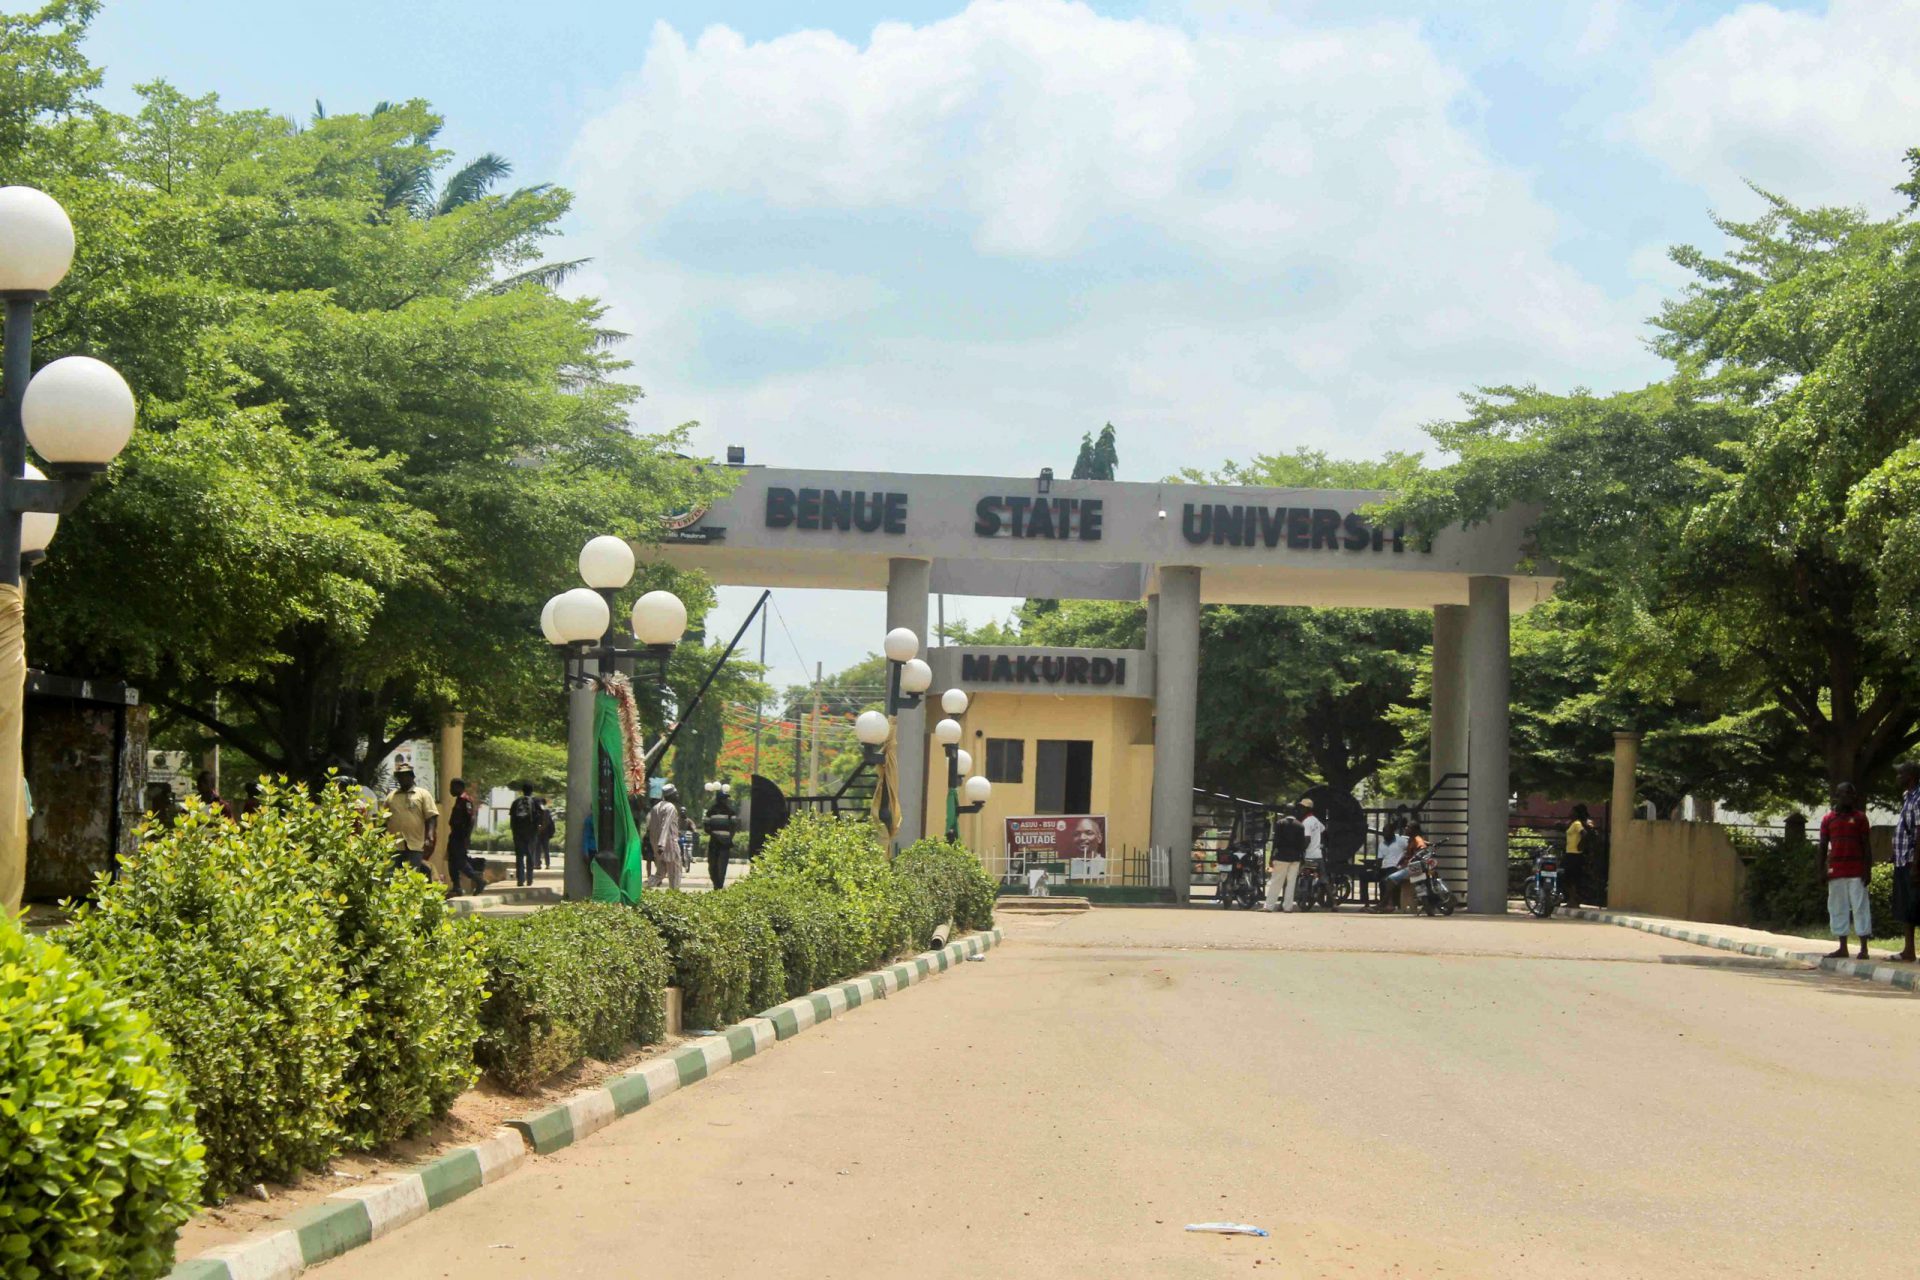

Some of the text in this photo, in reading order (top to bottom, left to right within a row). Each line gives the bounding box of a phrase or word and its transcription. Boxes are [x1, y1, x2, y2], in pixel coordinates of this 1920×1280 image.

[766, 487, 908, 534] BENUE
[975, 495, 1103, 540] STATE
[962, 654, 1126, 685] MAKURDI
[1015, 835, 1056, 844] OLUTADE
